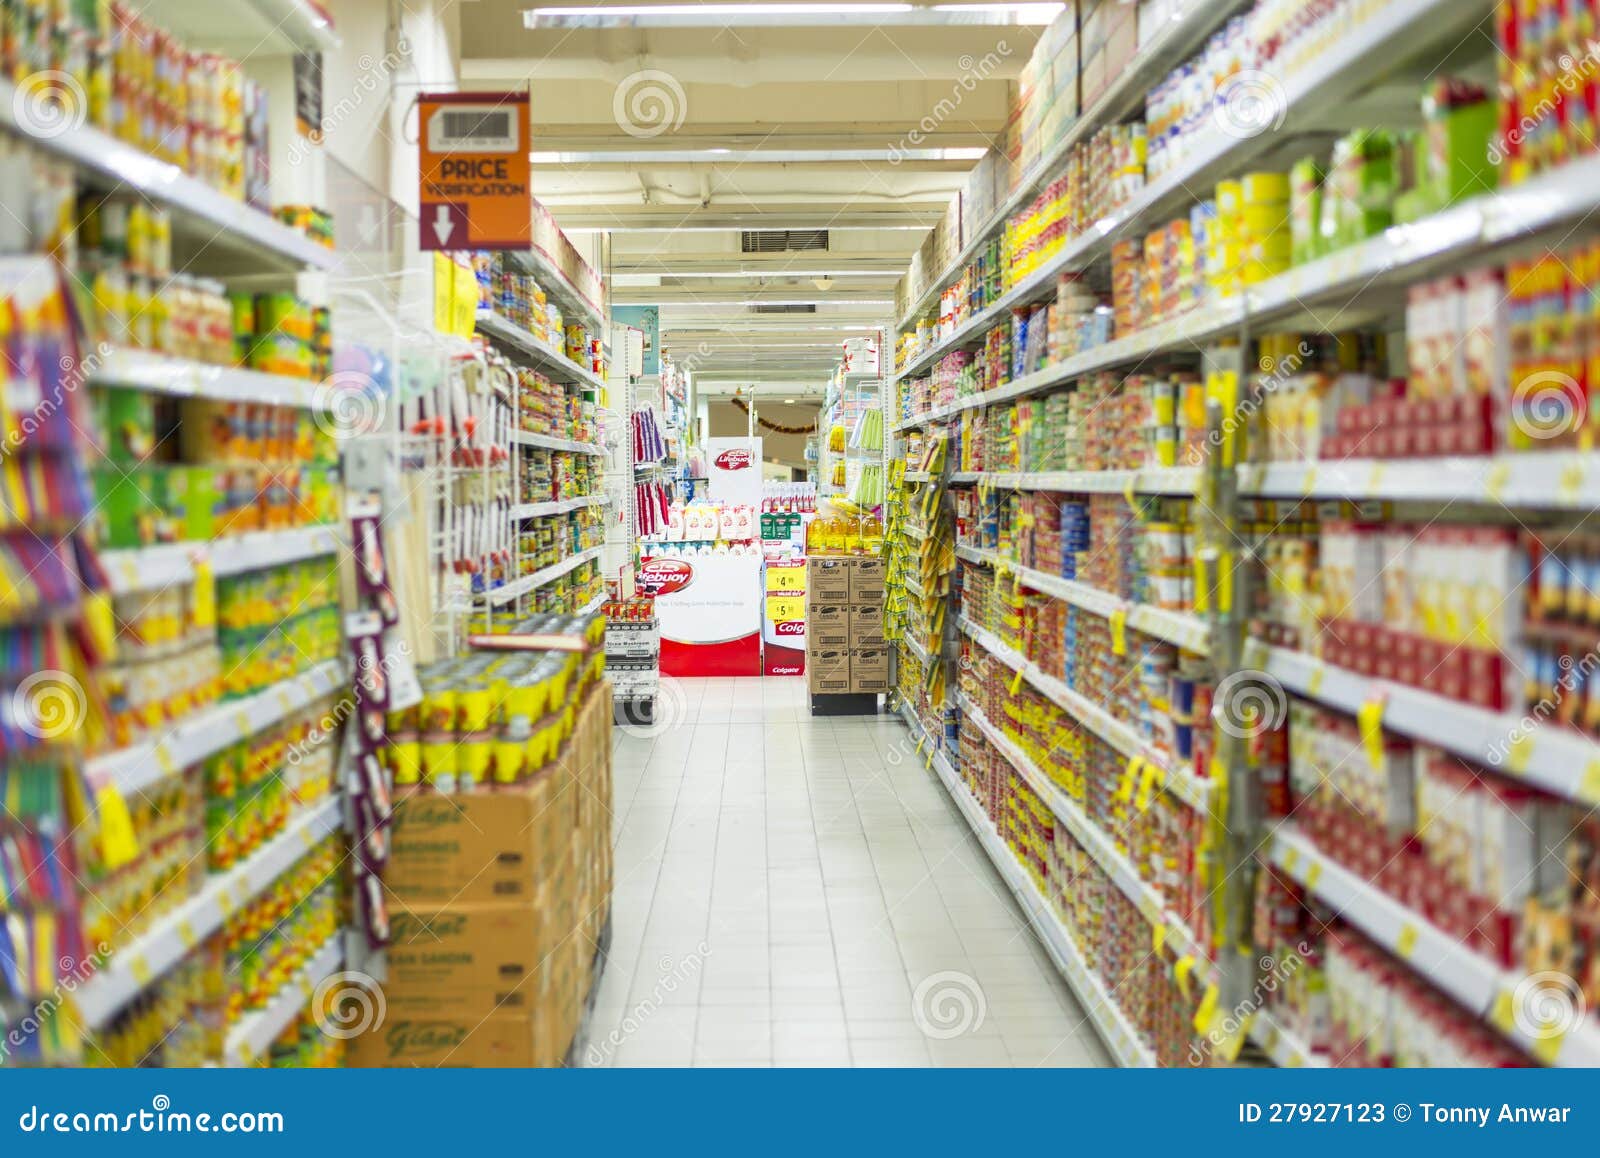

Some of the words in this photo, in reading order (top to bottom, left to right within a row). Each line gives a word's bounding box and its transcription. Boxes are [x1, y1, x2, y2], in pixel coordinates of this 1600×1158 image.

[441, 159, 508, 179] PRICE
[426, 183, 525, 195] VERIFICATION
[637, 571, 689, 584] ifebuoy
[778, 623, 804, 634] Colg
